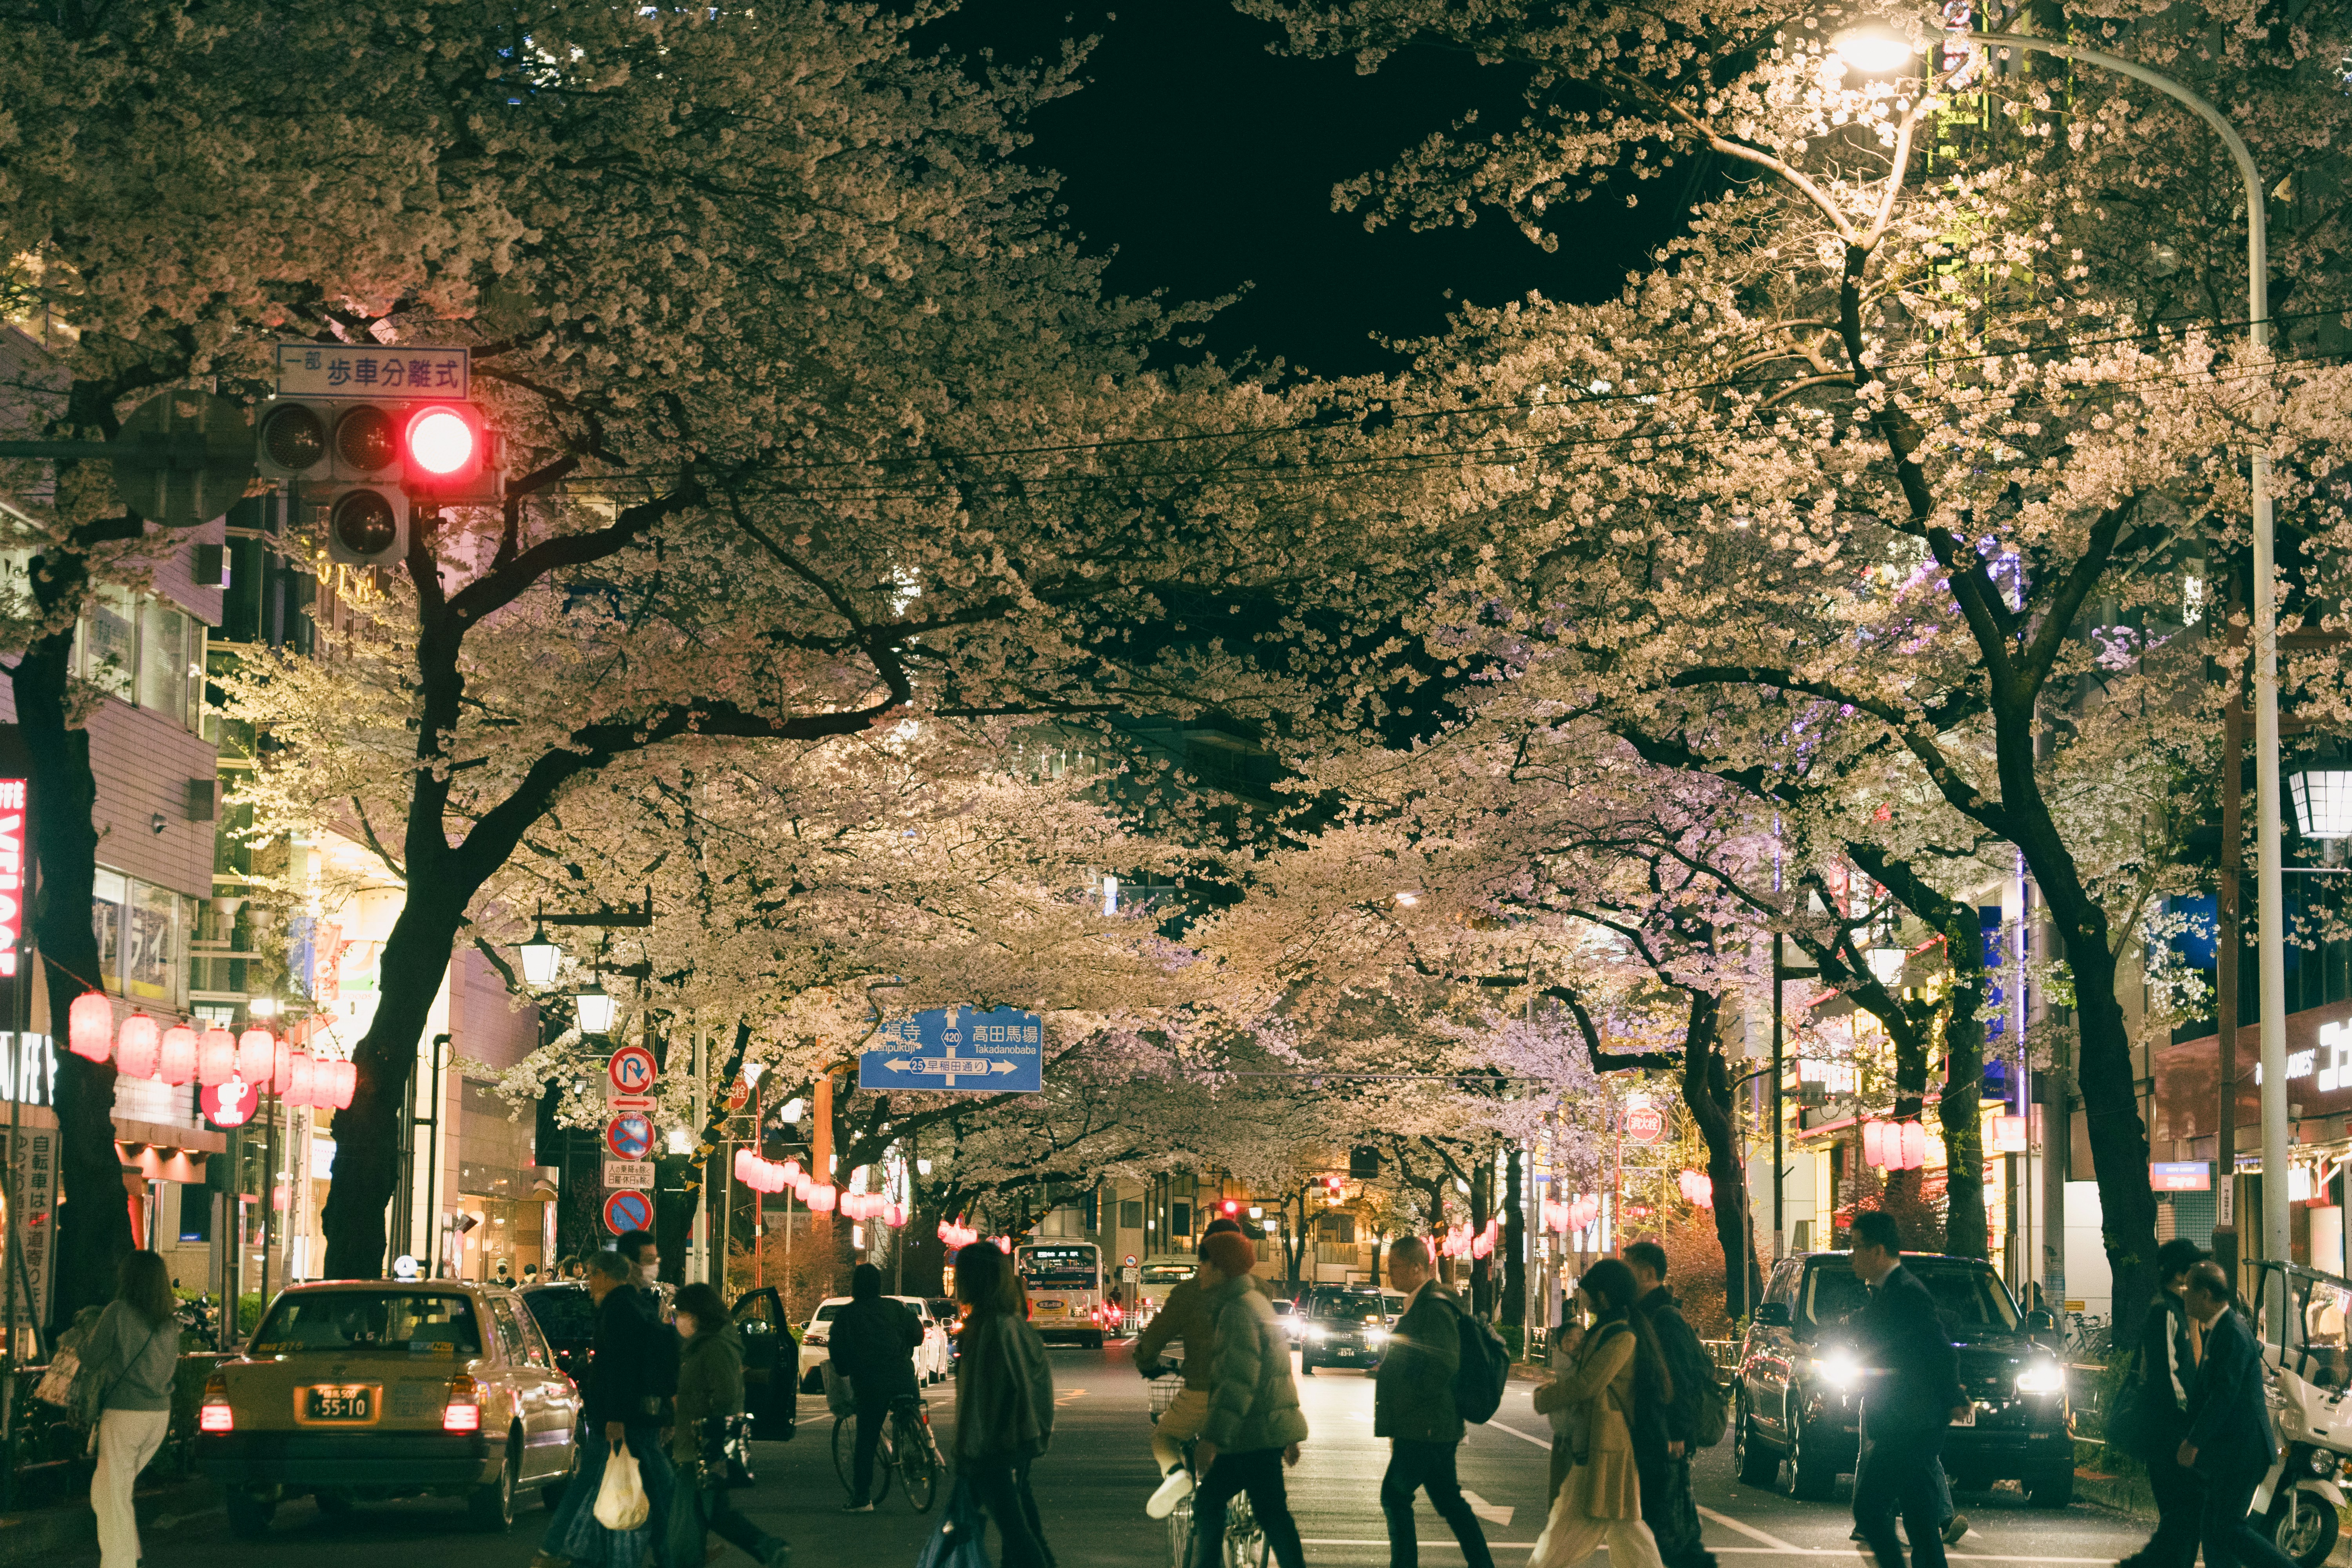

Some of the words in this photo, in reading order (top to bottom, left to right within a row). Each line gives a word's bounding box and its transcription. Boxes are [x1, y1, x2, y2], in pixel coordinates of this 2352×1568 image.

[286, 352, 321, 370] 一部
[328, 358, 458, 388] 歩車分離式
[866, 1024, 921, 1041] 福寺
[944, 1033, 959, 1042] 420
[973, 1025, 1038, 1043] 高田馬場
[871, 1044, 915, 1054] enpukuji
[975, 1044, 1036, 1054] Takadanobaba
[912, 1062, 923, 1070] 25
[927, 1061, 984, 1072] 早稲田通り
[1631, 1116, 1659, 1131] 消火栓
[608, 1164, 650, 1174] 人の乗降を除く
[322, 1399, 365, 1416] 55-10
